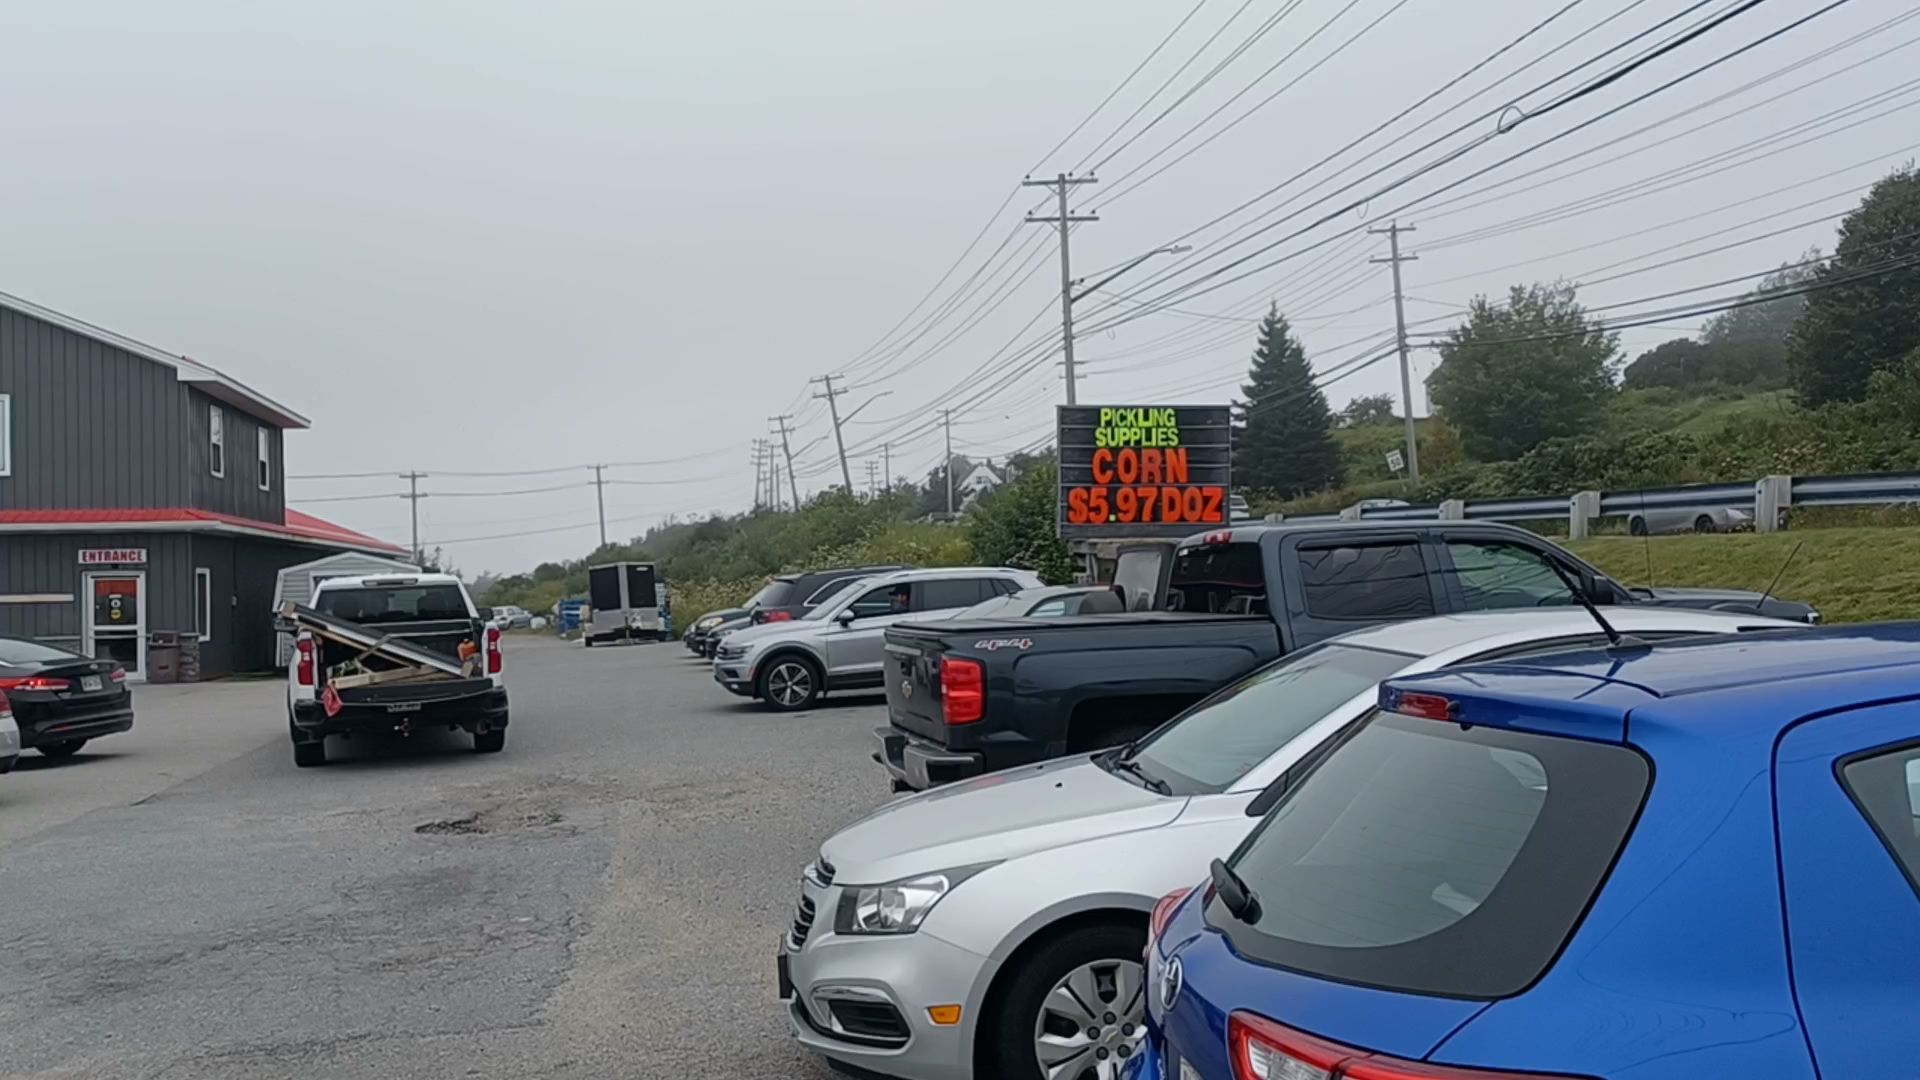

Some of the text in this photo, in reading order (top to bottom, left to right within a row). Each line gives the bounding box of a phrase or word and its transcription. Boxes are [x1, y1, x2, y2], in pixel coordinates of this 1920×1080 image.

[1100, 408, 1176, 427] PICKLING
[1095, 427, 1179, 447] SUPPLIES
[1092, 448, 1188, 484] CORN
[1067, 487, 1223, 524] $5.97 DOZ
[82, 550, 143, 562] ENTRANCE
